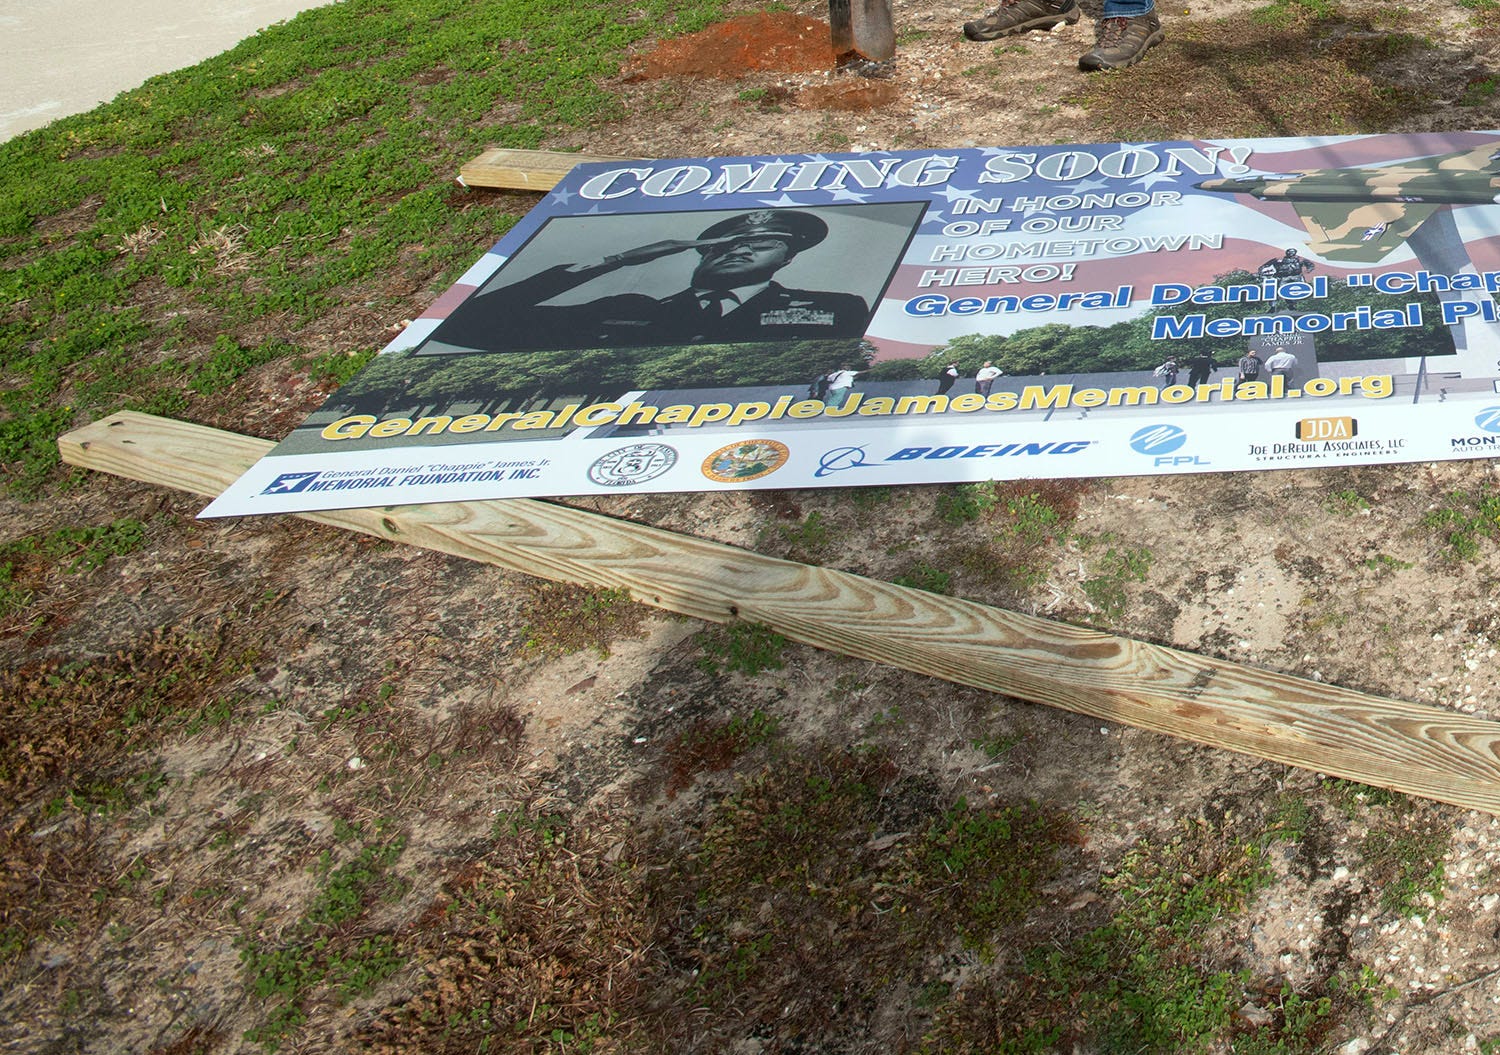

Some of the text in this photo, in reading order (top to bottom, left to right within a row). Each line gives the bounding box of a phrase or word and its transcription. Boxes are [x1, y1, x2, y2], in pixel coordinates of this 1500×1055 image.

[578, 146, 1255, 200] COMING SOON!
[951, 190, 1183, 216] IN HONOR
[942, 214, 1124, 239] OF OUR
[929, 232, 1225, 263] HOMETOWN
[917, 263, 1079, 289] HERO!
[903, 284, 1133, 317] General
[1150, 274, 1328, 307] Daniel
[1150, 302, 1423, 341] Memorial
[320, 372, 1395, 441] GeneralChappieJamesMemorial.org
[1305, 418, 1348, 439] JDA
[884, 440, 1091, 461] BOEING
[1255, 449, 1399, 462] STRUCTURAL ENGINEERS
[1388, 438, 1406, 449] LLC
[1451, 445, 1484, 453] AUTO
[321, 467, 378, 479] General
[377, 464, 425, 475] Daniel
[492, 459, 537, 469] James
[536, 458, 552, 467] Jr.
[1153, 455, 1212, 467] FPL
[308, 468, 541, 493] MEMORIAL FOUNDATION, INC.
